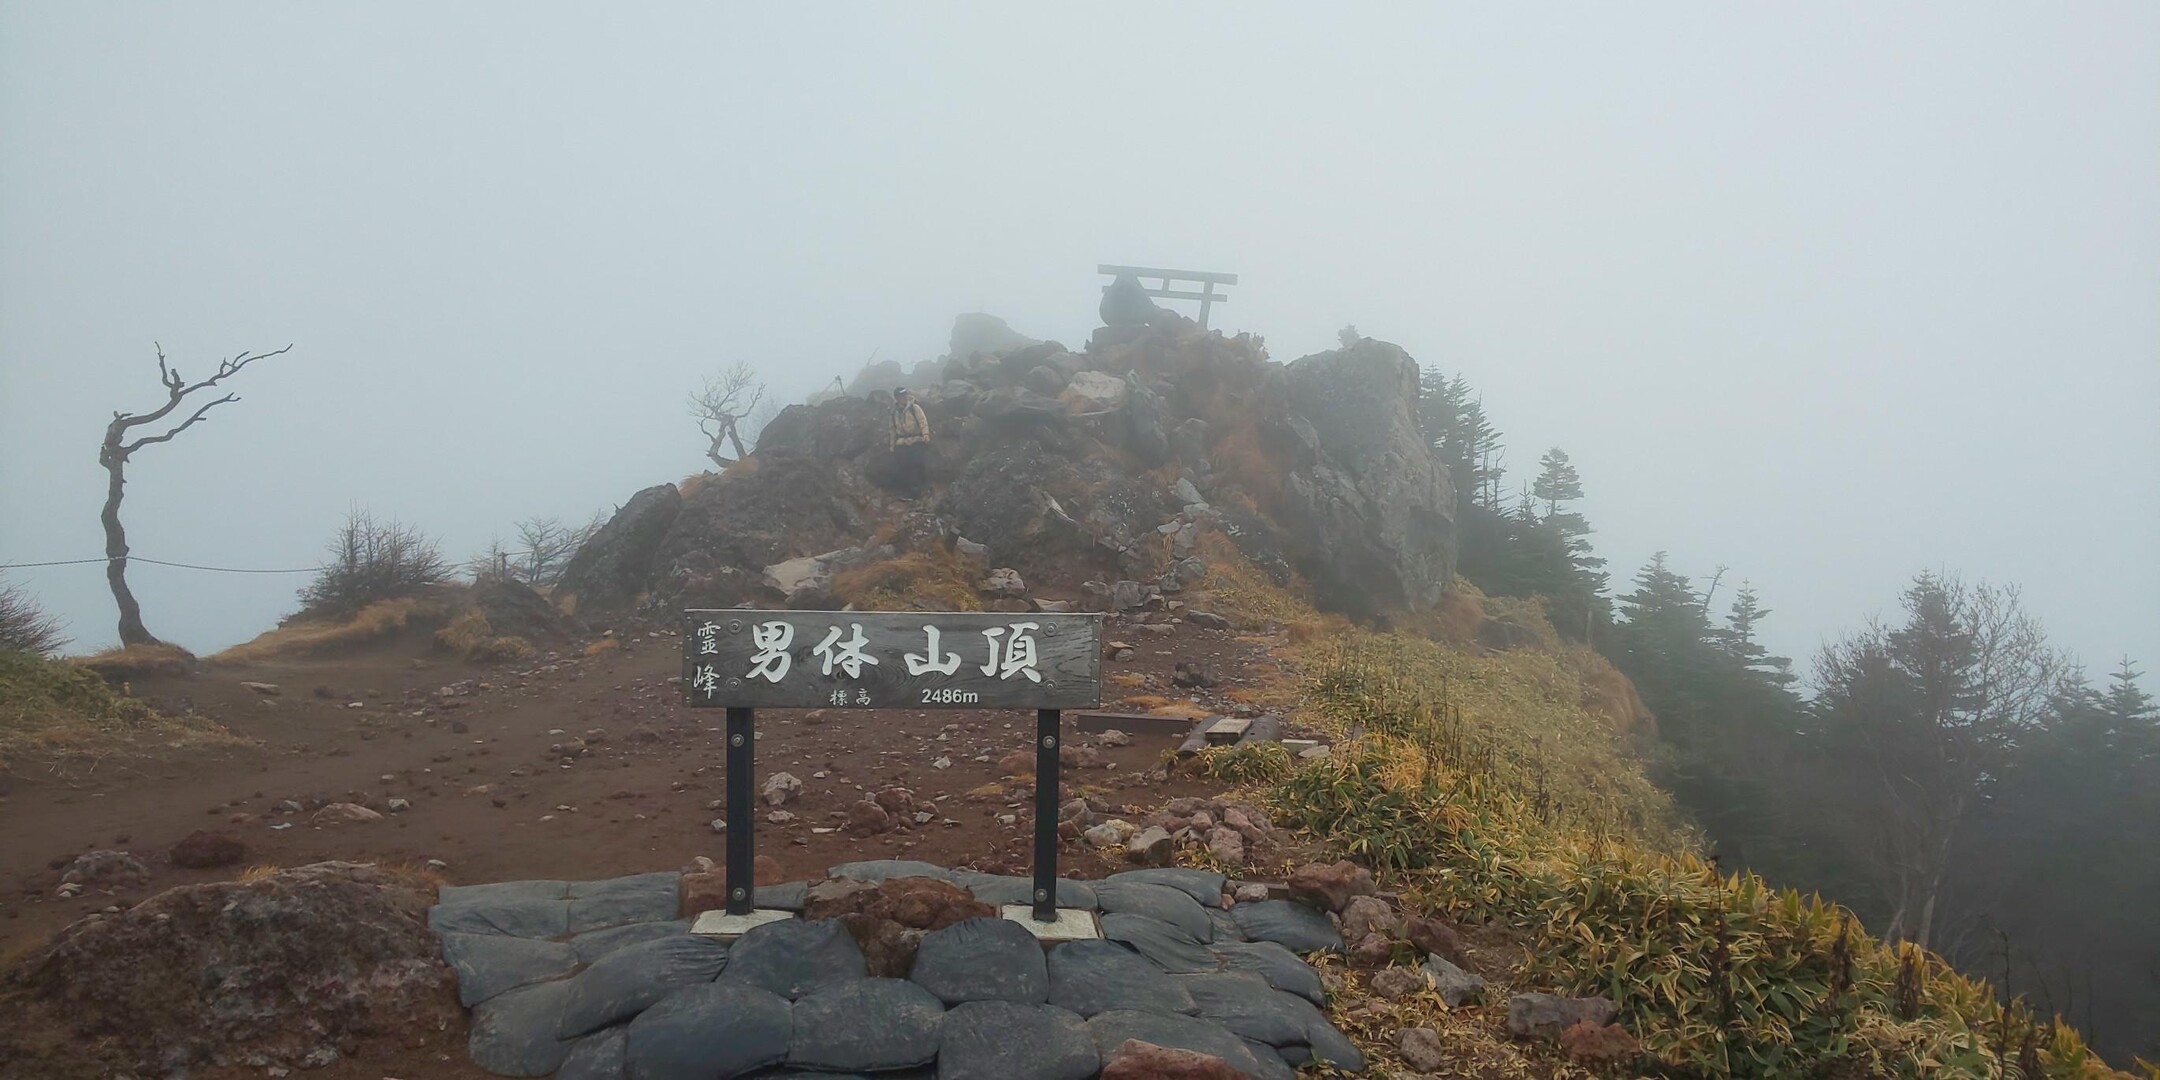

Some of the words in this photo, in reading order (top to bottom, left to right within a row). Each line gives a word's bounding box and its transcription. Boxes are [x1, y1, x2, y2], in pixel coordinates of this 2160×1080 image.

[745, 621, 1042, 683] 男体山頂
[829, 688, 871, 706] 標高
[921, 688, 978, 704] 2486m
